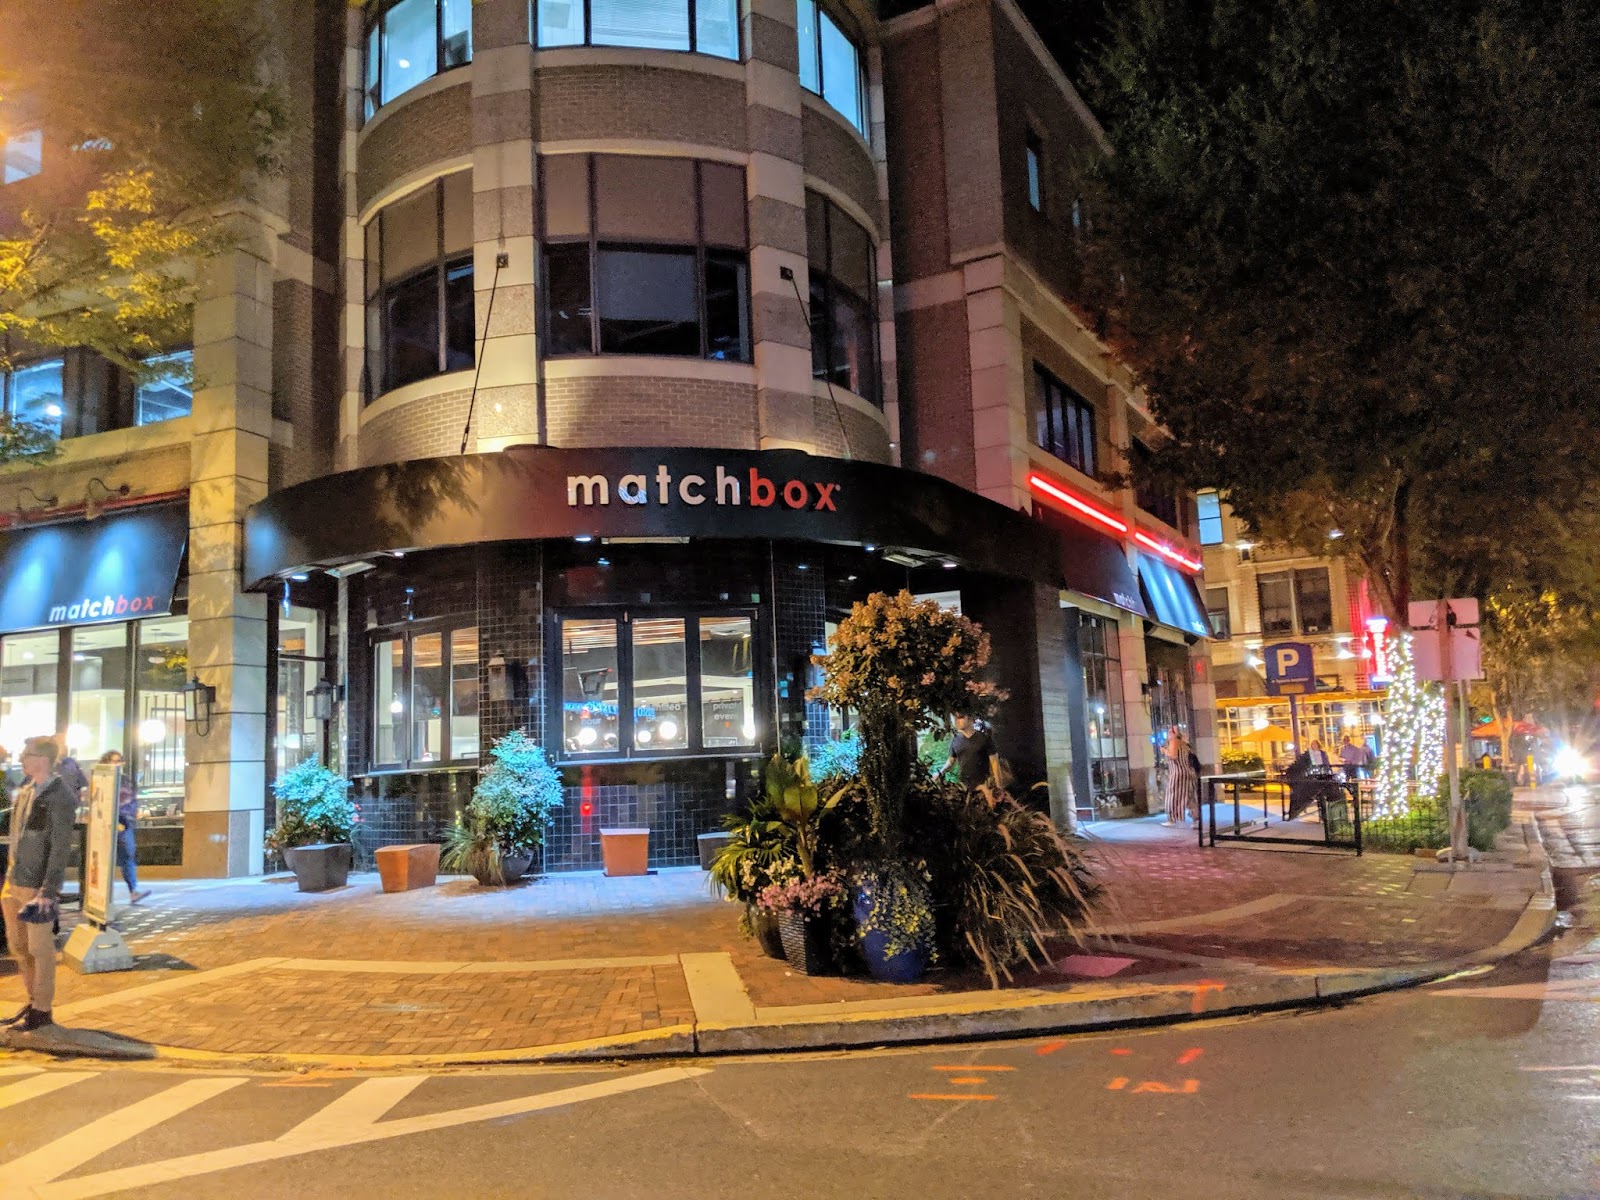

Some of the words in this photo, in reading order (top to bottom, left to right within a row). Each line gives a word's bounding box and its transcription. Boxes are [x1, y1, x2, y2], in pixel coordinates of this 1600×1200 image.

[567, 465, 837, 512] matchbox
[49, 594, 155, 622] matchbox
[1276, 648, 1299, 676] P
